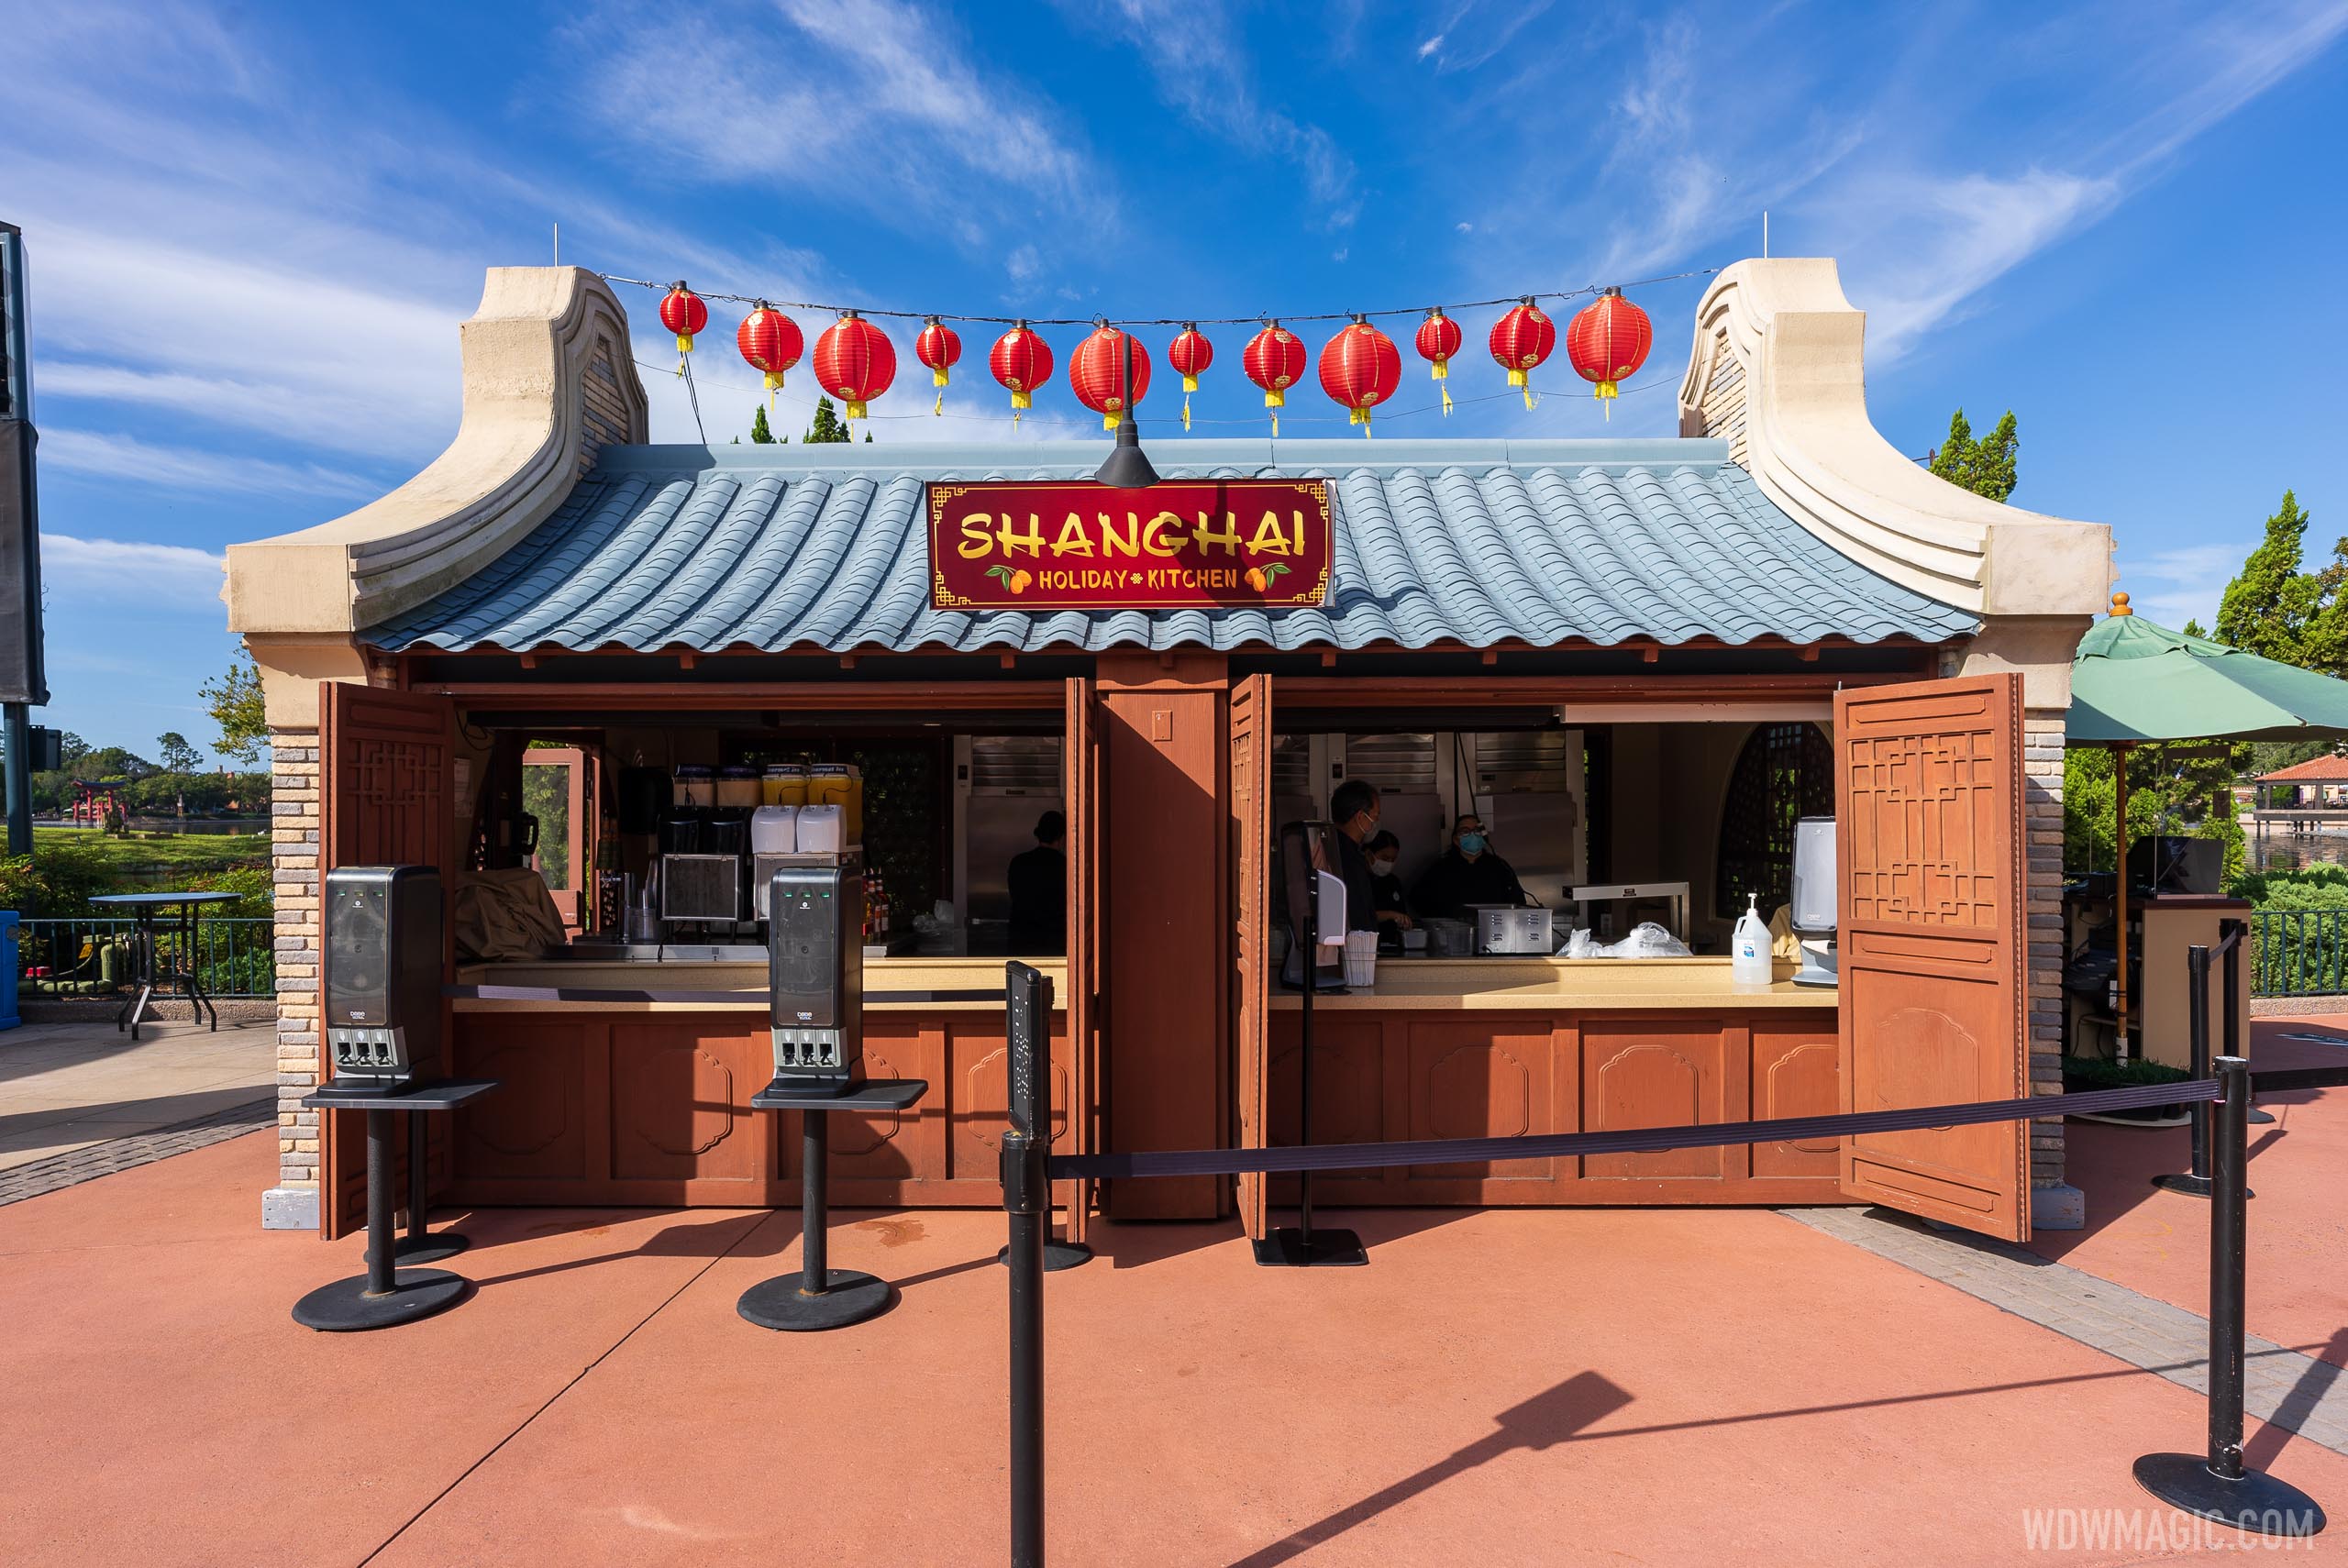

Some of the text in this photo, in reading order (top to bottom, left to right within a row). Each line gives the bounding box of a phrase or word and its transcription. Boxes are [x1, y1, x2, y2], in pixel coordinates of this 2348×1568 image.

[957, 510, 1306, 558] SHANGHAI
[1039, 568, 1238, 590] HOLIDAY KITCHEN
